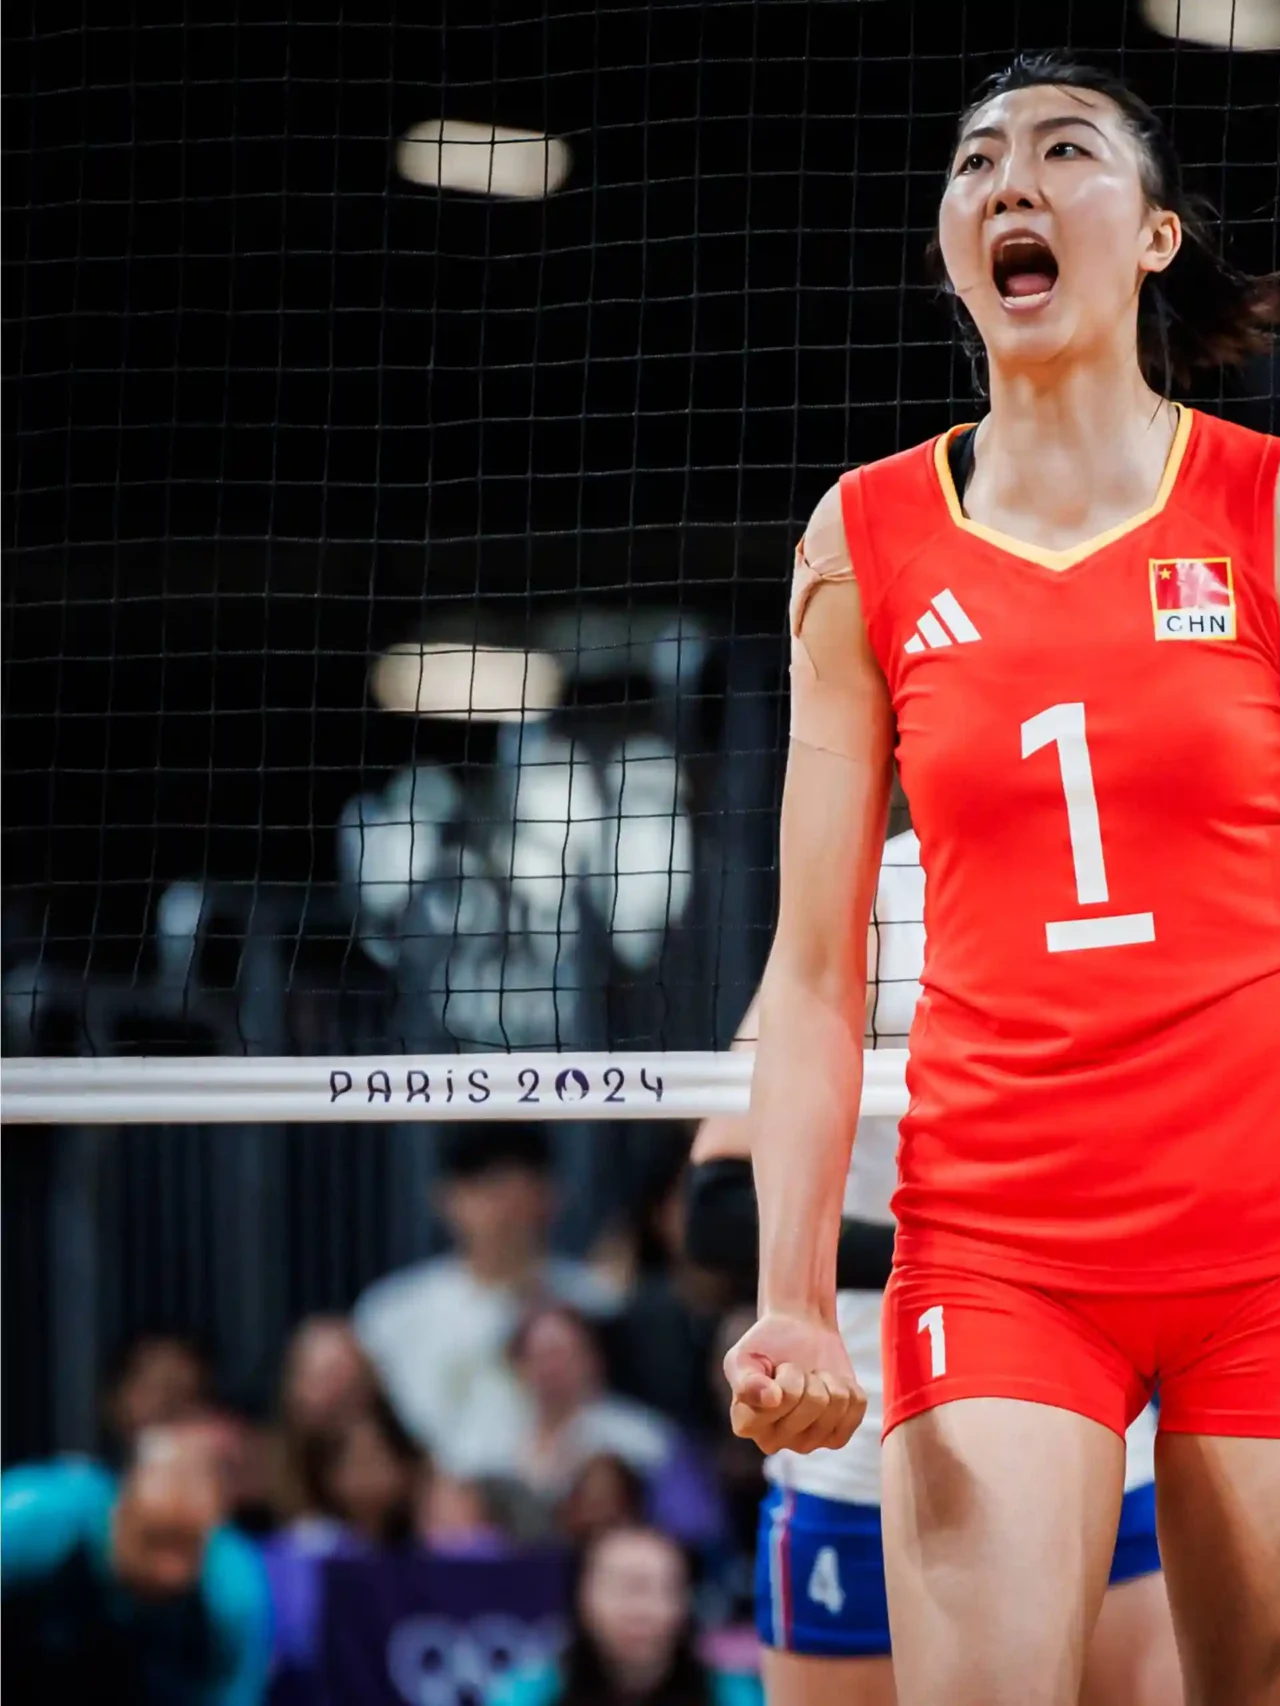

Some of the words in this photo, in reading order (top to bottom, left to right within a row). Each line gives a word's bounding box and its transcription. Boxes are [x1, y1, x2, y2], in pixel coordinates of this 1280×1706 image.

[1166, 614, 1226, 634] CHN
[1020, 702, 1110, 905] 1
[917, 1304, 947, 1378] 1
[807, 1546, 847, 1613] 4
